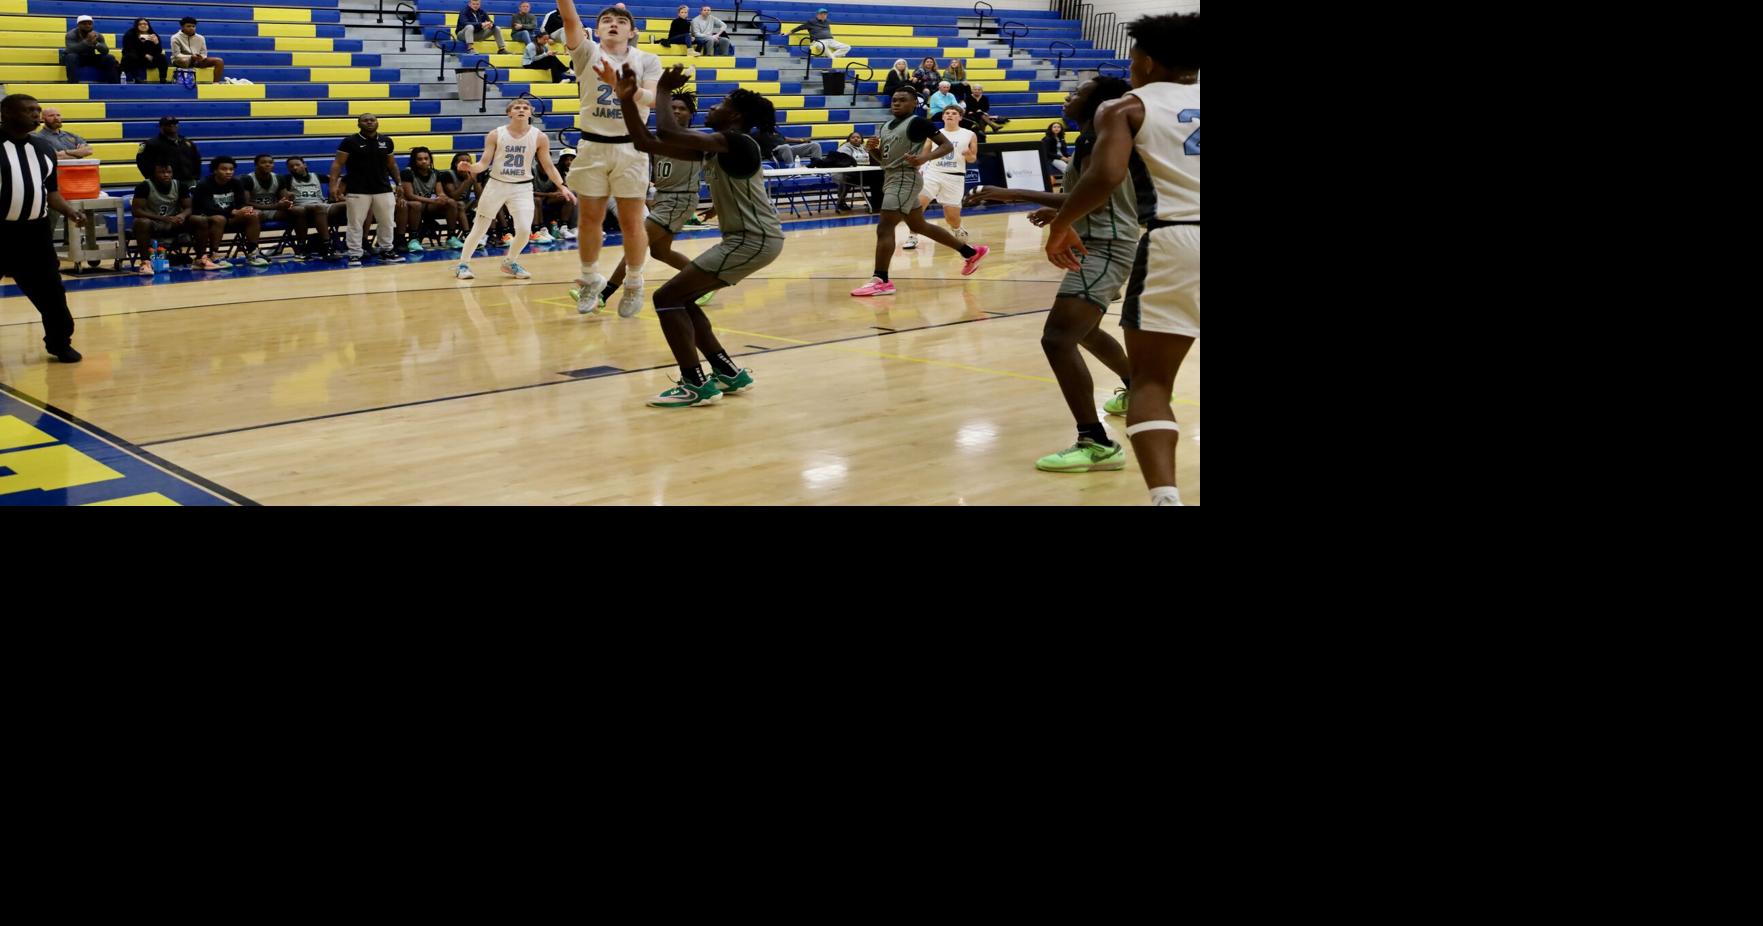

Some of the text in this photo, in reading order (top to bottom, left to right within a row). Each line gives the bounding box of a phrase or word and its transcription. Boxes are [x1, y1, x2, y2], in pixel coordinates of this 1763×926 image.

[597, 84, 622, 105] 2
[592, 107, 622, 118] JAME
[505, 145, 526, 153] SAINT
[503, 153, 524, 168] 20
[657, 161, 672, 178] 10
